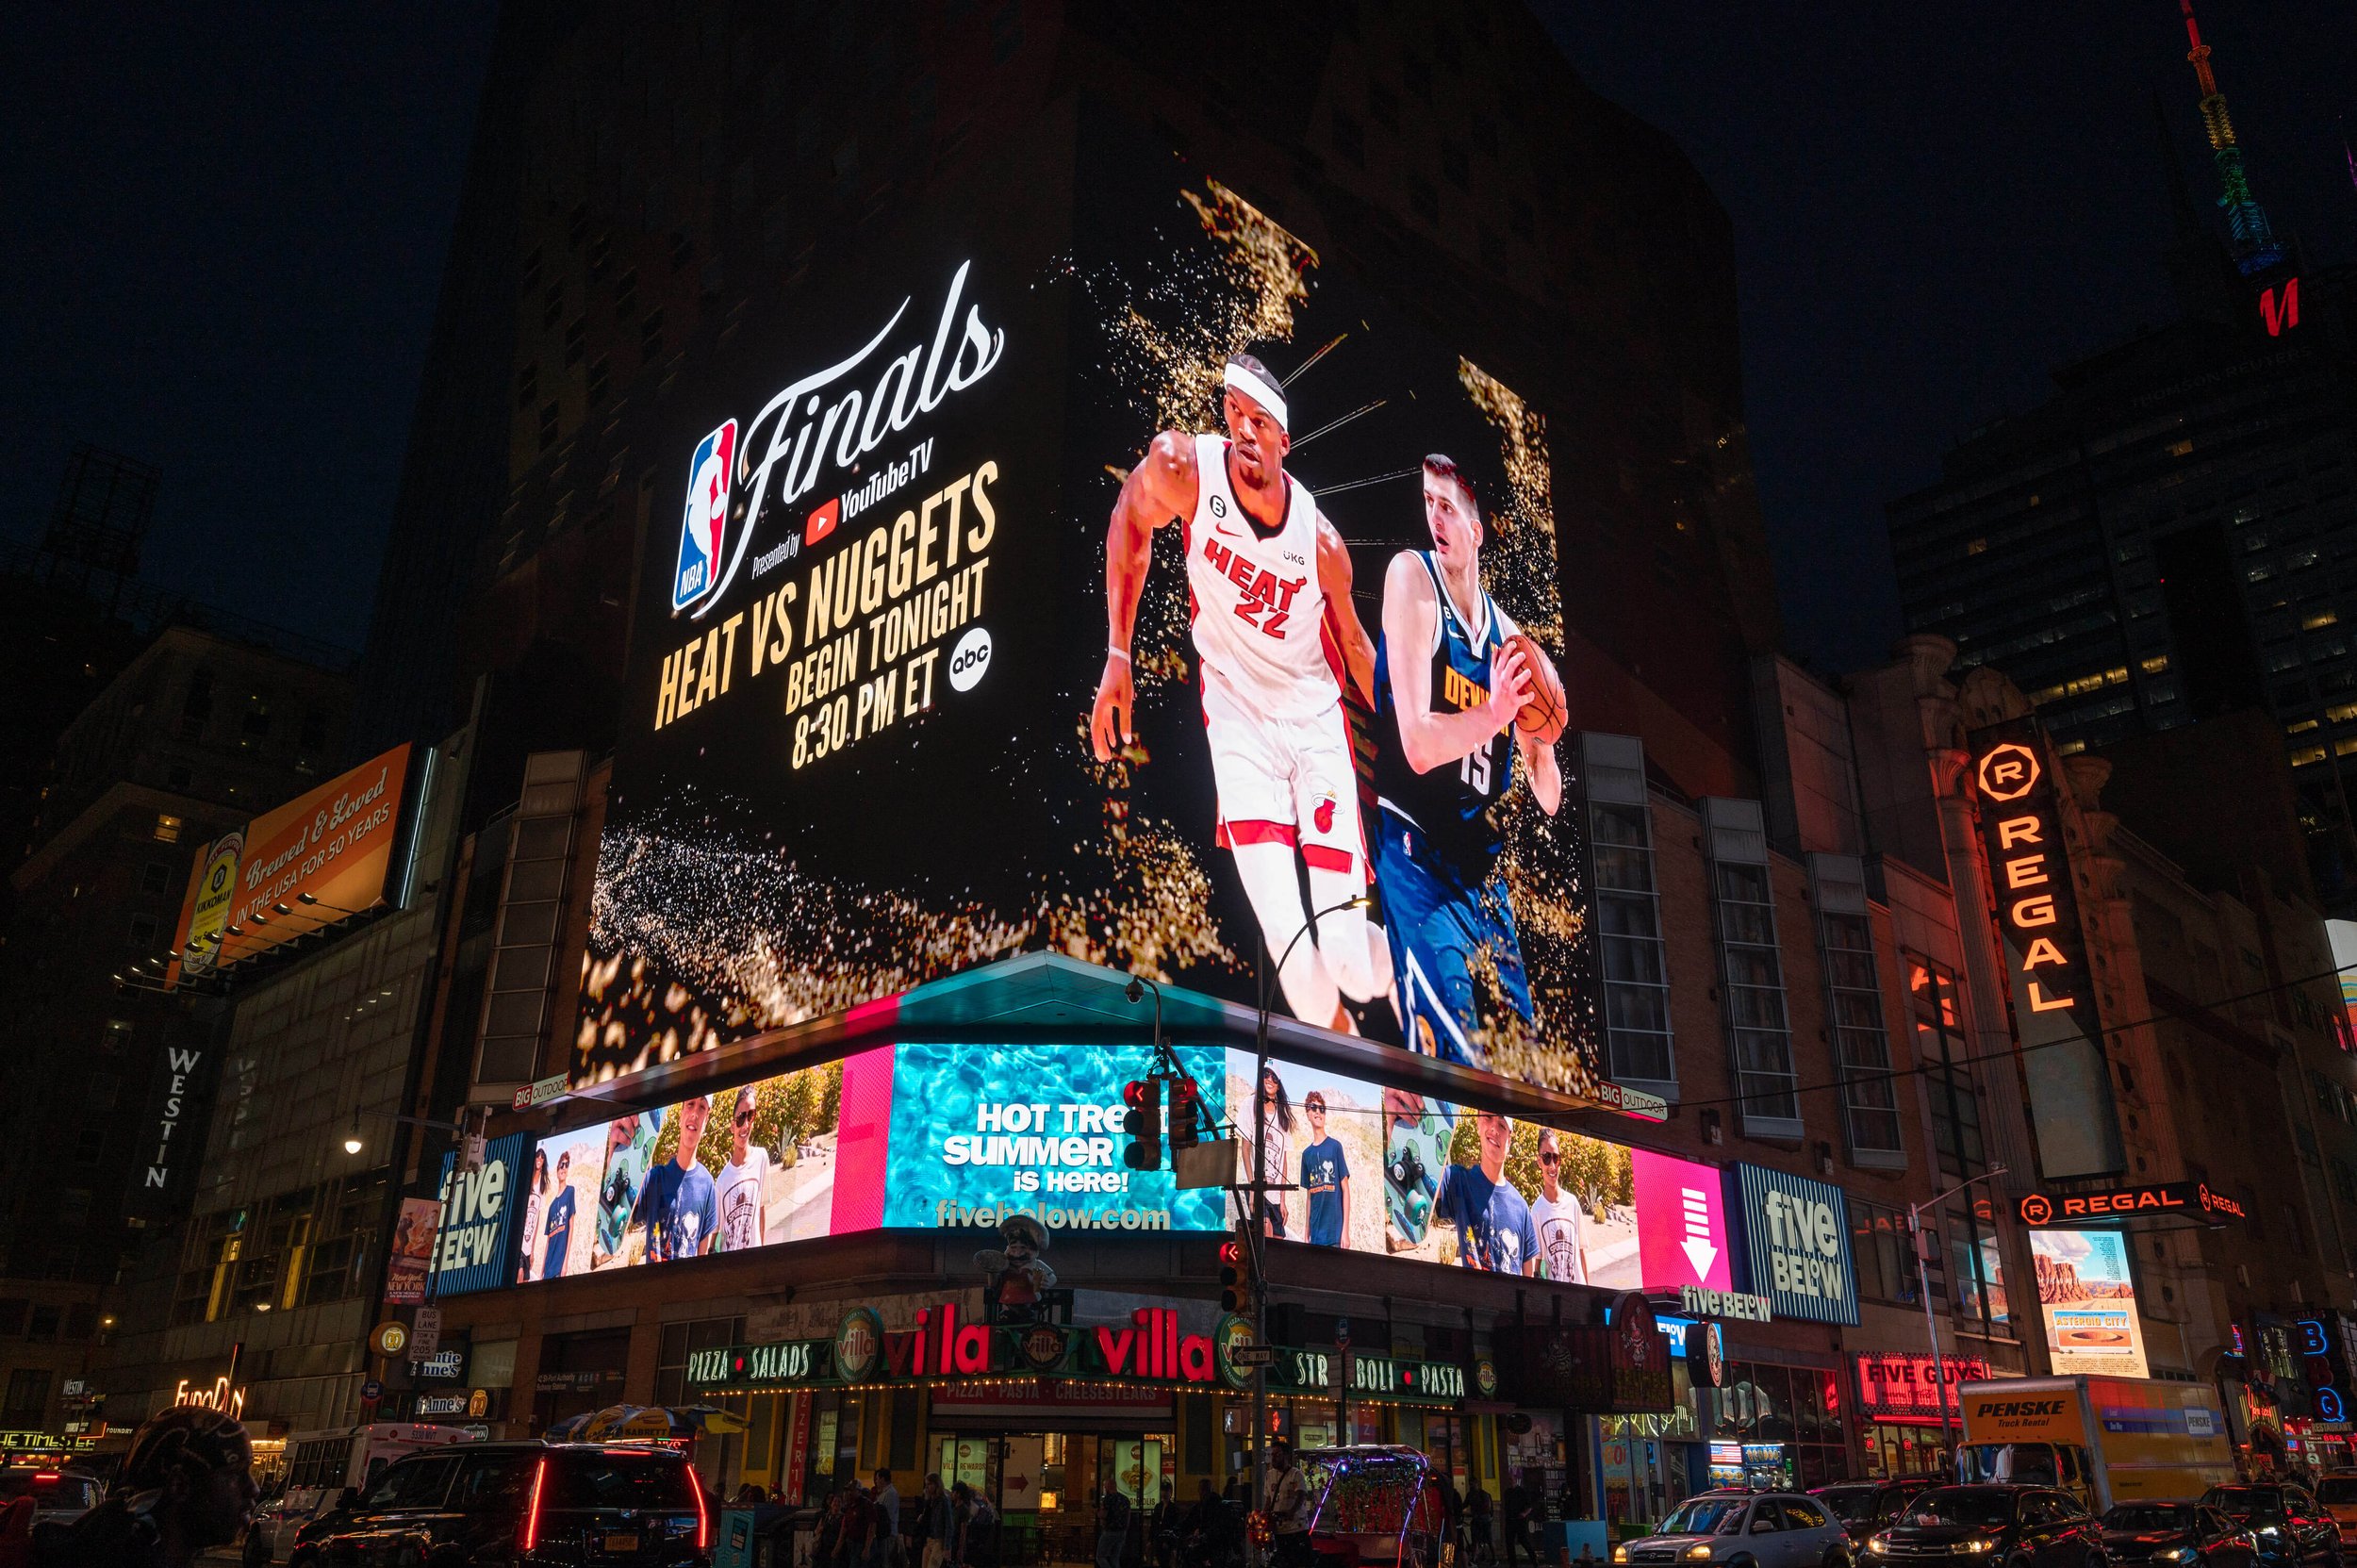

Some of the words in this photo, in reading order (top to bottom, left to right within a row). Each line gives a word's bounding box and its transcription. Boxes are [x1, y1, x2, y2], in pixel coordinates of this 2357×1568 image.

[691, 260, 1004, 619] Finals
[1211, 496, 1225, 518] 6
[752, 540, 789, 580] Presented
[788, 533, 800, 564] by
[1283, 551, 1306, 566] UKG
[678, 560, 703, 599] NBA
[1204, 537, 1308, 612] HEAT
[654, 611, 744, 731] HEAT
[751, 580, 797, 678] VS
[805, 460, 998, 648] NUGGETS
[1443, 606, 1452, 619] 6
[1234, 590, 1289, 639] 22
[785, 630, 859, 716] BEGIN
[869, 557, 988, 665] TONIGHT
[952, 638, 989, 675] abc
[792, 695, 849, 769] 8:30
[855, 680, 896, 740] PM
[903, 648, 939, 719] ET
[246, 825, 308, 891] Brewed
[311, 810, 328, 843] &
[329, 767, 387, 831] Loved
[236, 904, 249, 926] IN
[251, 887, 273, 915] THE
[274, 873, 298, 899] USA
[300, 850, 325, 881] FOR
[328, 835, 345, 861] 50
[348, 802, 390, 846] YEARS
[196, 888, 233, 914] KIKKOMAN
[1998, 816, 2074, 1013] REGAL
[515, 1088, 532, 1107] BIG
[1601, 1084, 1621, 1104] BIG
[1624, 1094, 1665, 1114] OUTDOOR
[144, 1047, 202, 1188] WESTIN
[977, 1103, 1050, 1132] HOT
[935, 1199, 1171, 1230] fiveblow.com
[2065, 1190, 2184, 1215] REGAL
[2211, 1195, 2245, 1217] REGAL
[1766, 1190, 1838, 1258] five
[387, 1282, 404, 1291] NEW
[404, 1282, 424, 1291] YORK
[1772, 1251, 1842, 1301] BELOW
[1683, 1284, 1721, 1315] five
[1722, 1292, 1772, 1322] BELOW
[2056, 1316, 2102, 1327] ASTEROID
[2103, 1316, 2128, 1327] CITY
[837, 1330, 876, 1358] villa
[882, 1302, 992, 1377] villa
[1022, 1334, 1064, 1356] villa
[1097, 1307, 1215, 1381] villa
[1239, 1352, 1251, 1361] ONE
[1255, 1351, 1268, 1361] WAY
[688, 1350, 728, 1382] PIZZA
[750, 1344, 810, 1379] SALADS
[1295, 1352, 1394, 1392] STRBOLI
[1421, 1364, 1465, 1397] PASTA
[1867, 1364, 1916, 1383] FIVE
[1924, 1365, 1985, 1384] GUYS
[2297, 1320, 2346, 1422] BBQ
[63, 1378, 85, 1395] WESTIN
[947, 1380, 983, 1398] PIZZA
[999, 1381, 1040, 1399] PASTA
[1056, 1383, 1157, 1400] CHEESESTEAKS
[1977, 1399, 2066, 1418] PENSKE
[1998, 1418, 2019, 1428] Truck
[2021, 1417, 2050, 1428] Rental
[2188, 1416, 2211, 1428] PENSKE
